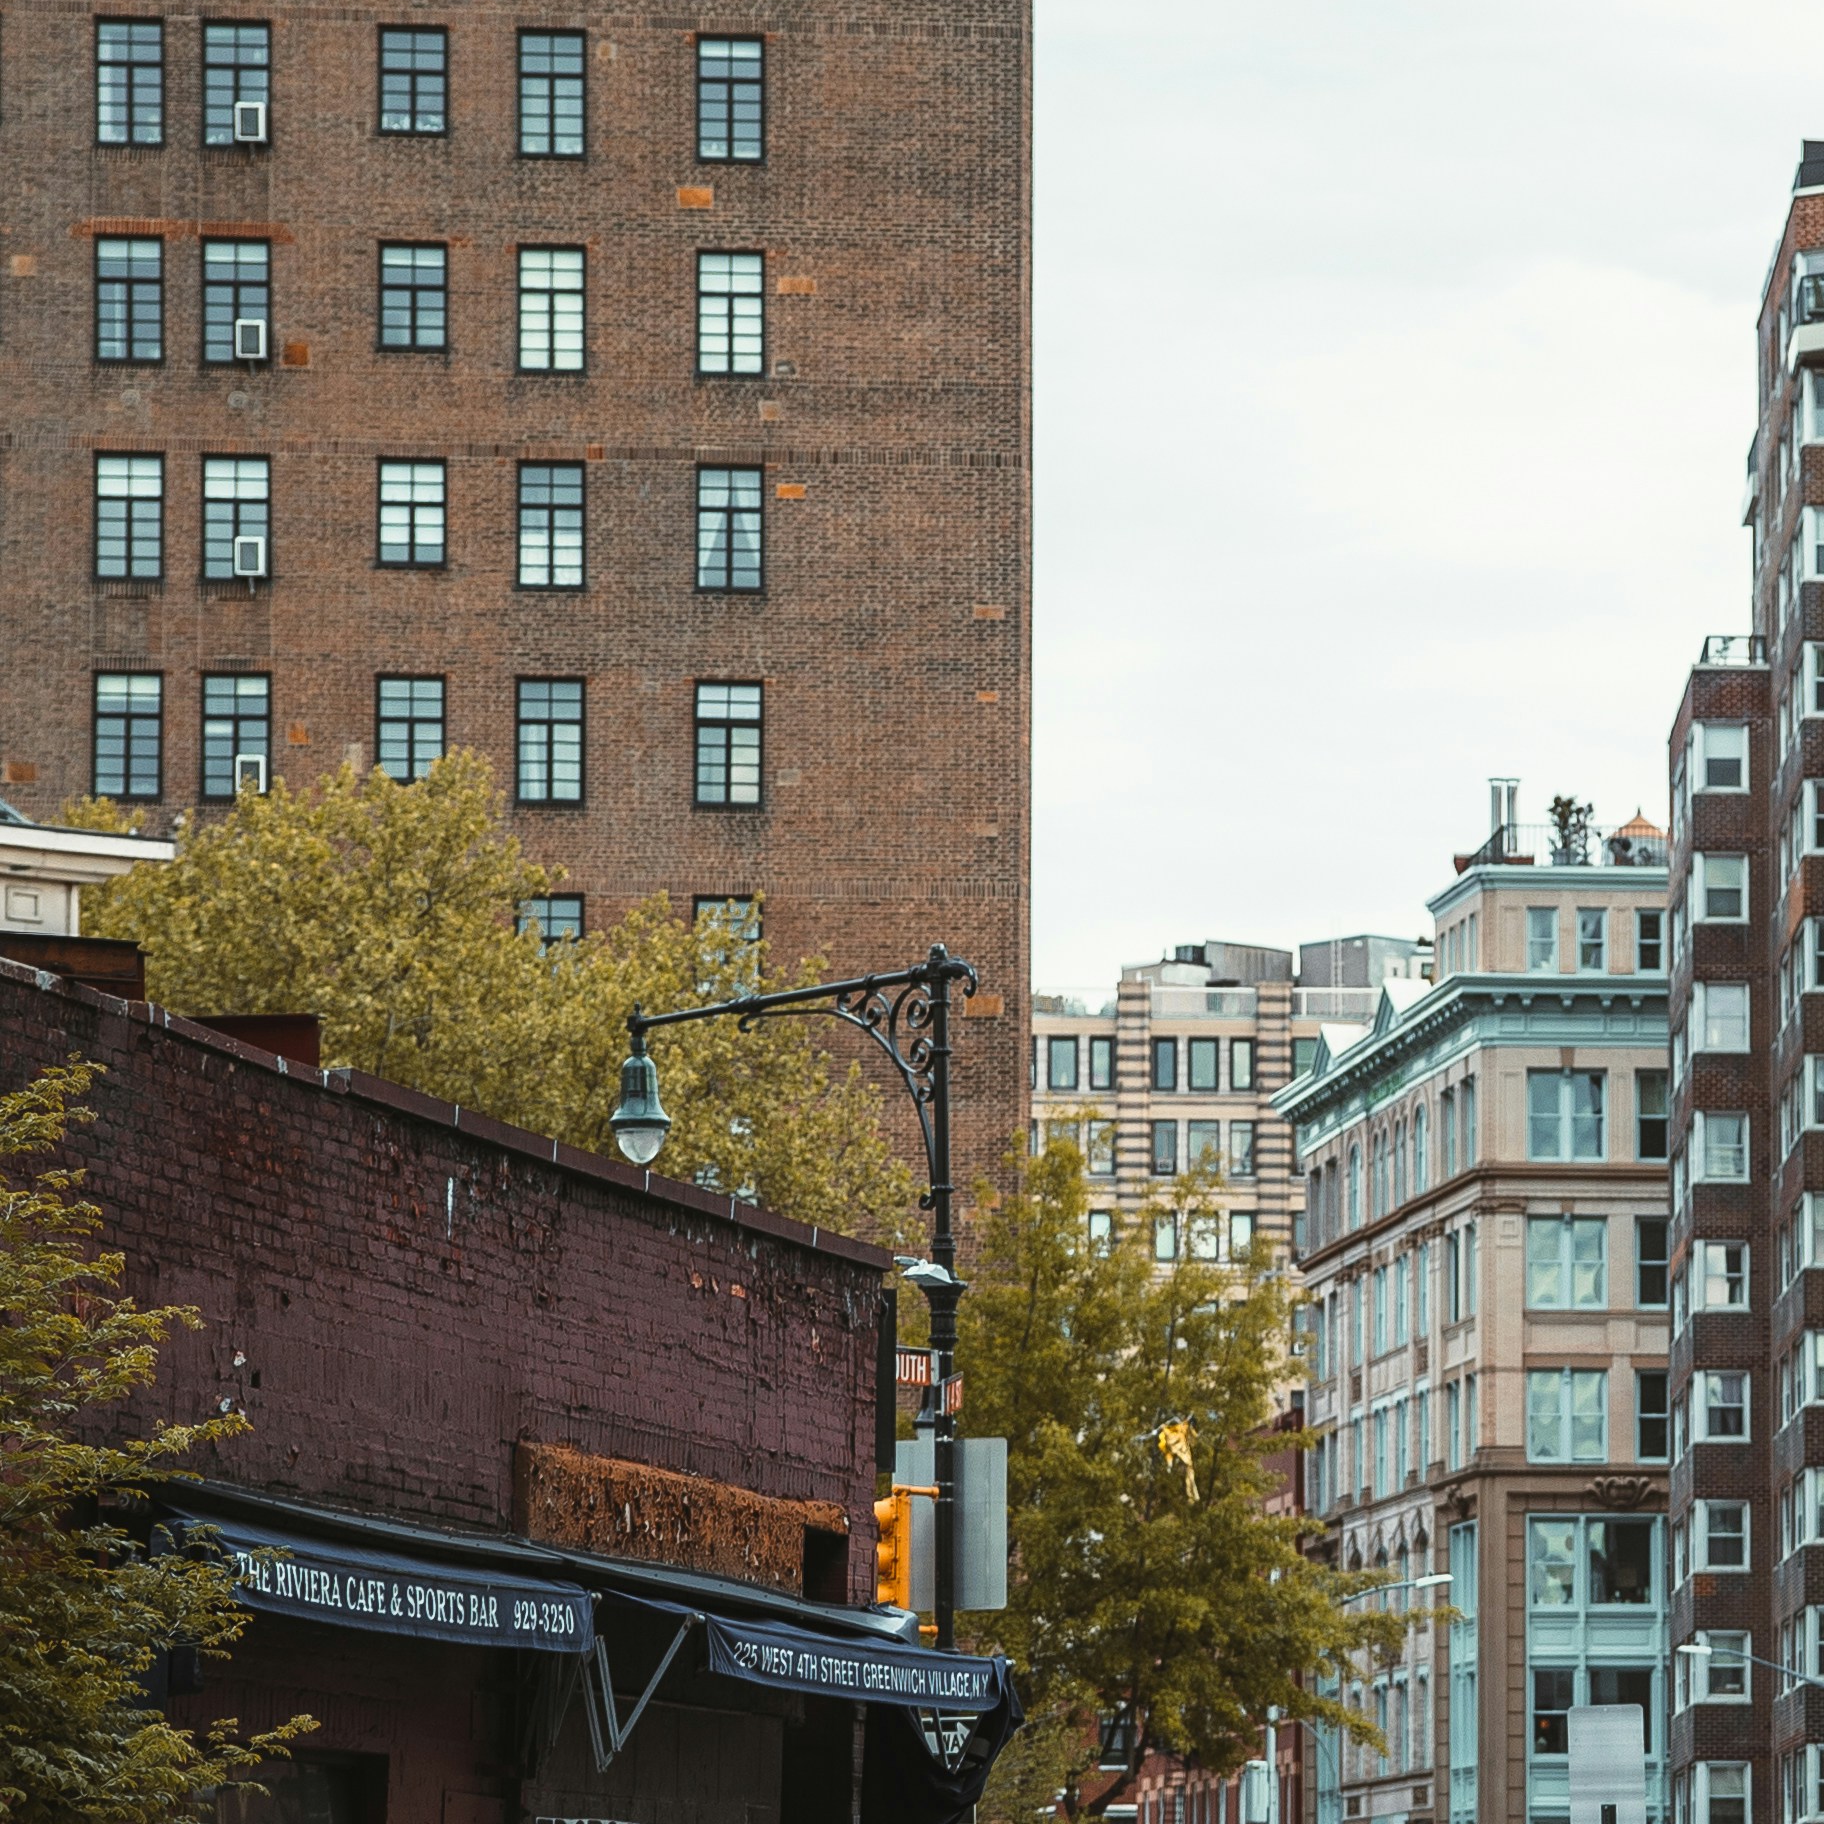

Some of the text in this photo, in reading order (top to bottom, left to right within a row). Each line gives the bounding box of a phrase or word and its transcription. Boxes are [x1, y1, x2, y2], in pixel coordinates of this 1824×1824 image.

[275, 1561, 342, 1609] RIVIERA
[346, 1576, 386, 1615] CAFE
[390, 1584, 403, 1617] &
[407, 1585, 464, 1626] SPORTS
[469, 1595, 499, 1628] BAR
[514, 1600, 574, 1635] 929-3250
[733, 1641, 758, 1668] 225
[761, 1645, 794, 1676] WEST
[796, 1653, 818, 1681] 4TH
[820, 1656, 860, 1687] STREET
[863, 1664, 926, 1695] GREENWICH
